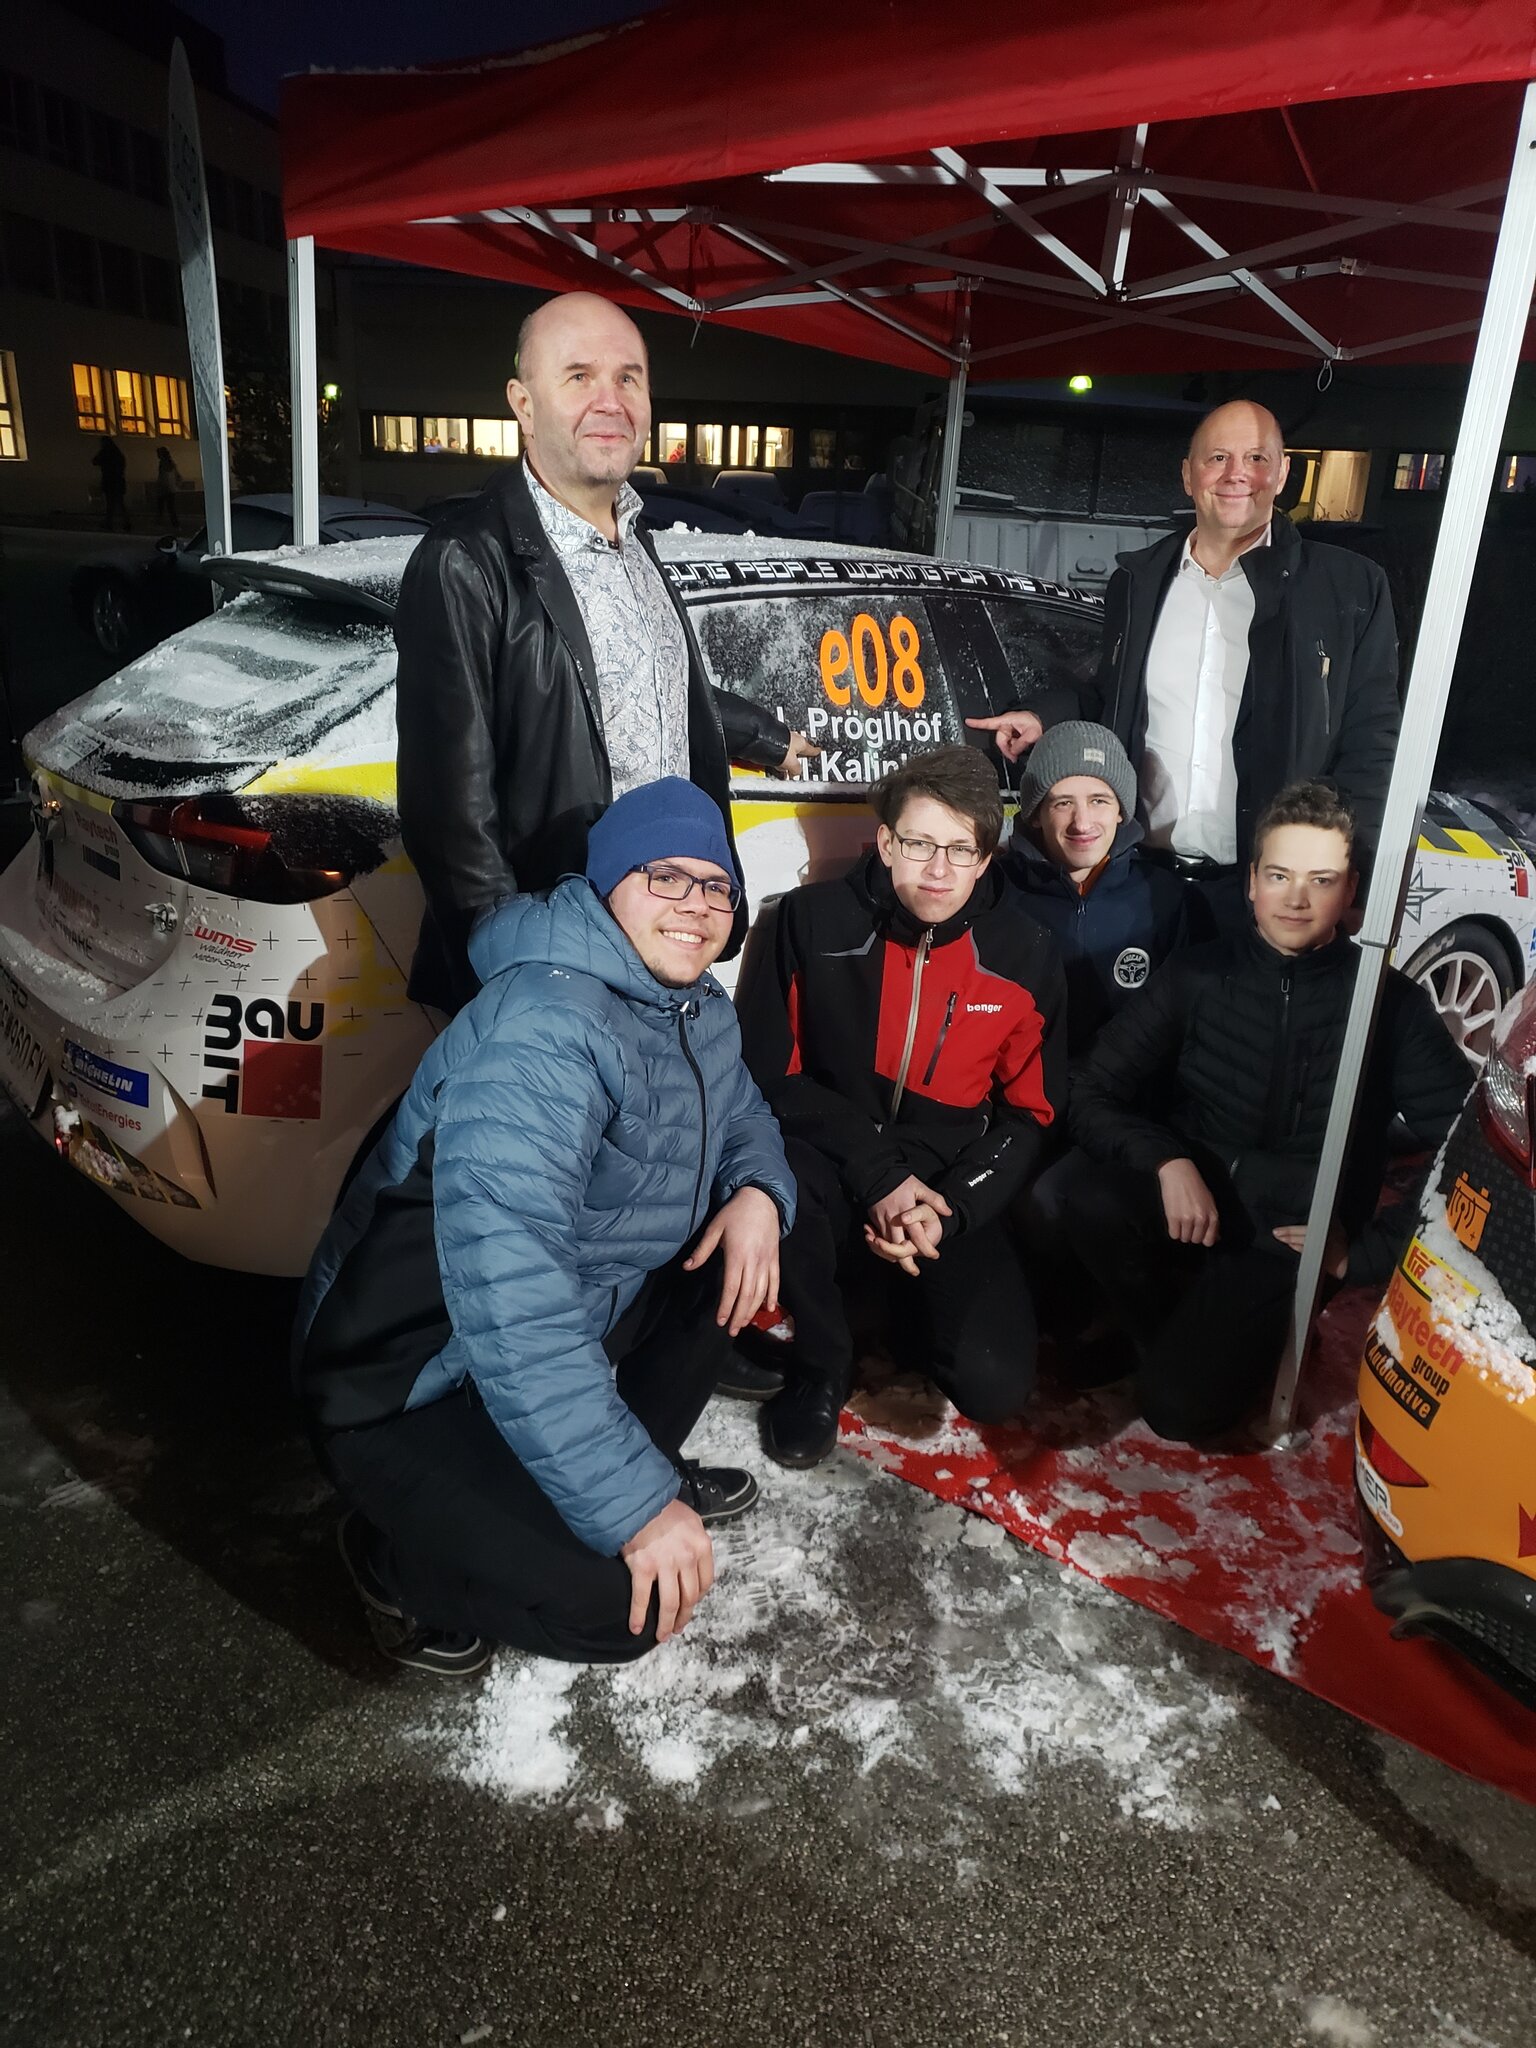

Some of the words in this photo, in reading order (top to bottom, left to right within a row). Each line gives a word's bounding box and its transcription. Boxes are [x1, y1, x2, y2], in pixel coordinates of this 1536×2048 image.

[663, 563, 731, 581] OUNG
[735, 561, 838, 579] PEOPLE
[841, 561, 942, 581] WORKING
[943, 567, 988, 586] FOR
[991, 572, 1036, 592] THE
[1038, 580, 1105, 605] FUTUR
[820, 613, 926, 708] e08
[1367, 1343, 1431, 1419] Automotive
[1411, 1354, 1450, 1397] group
